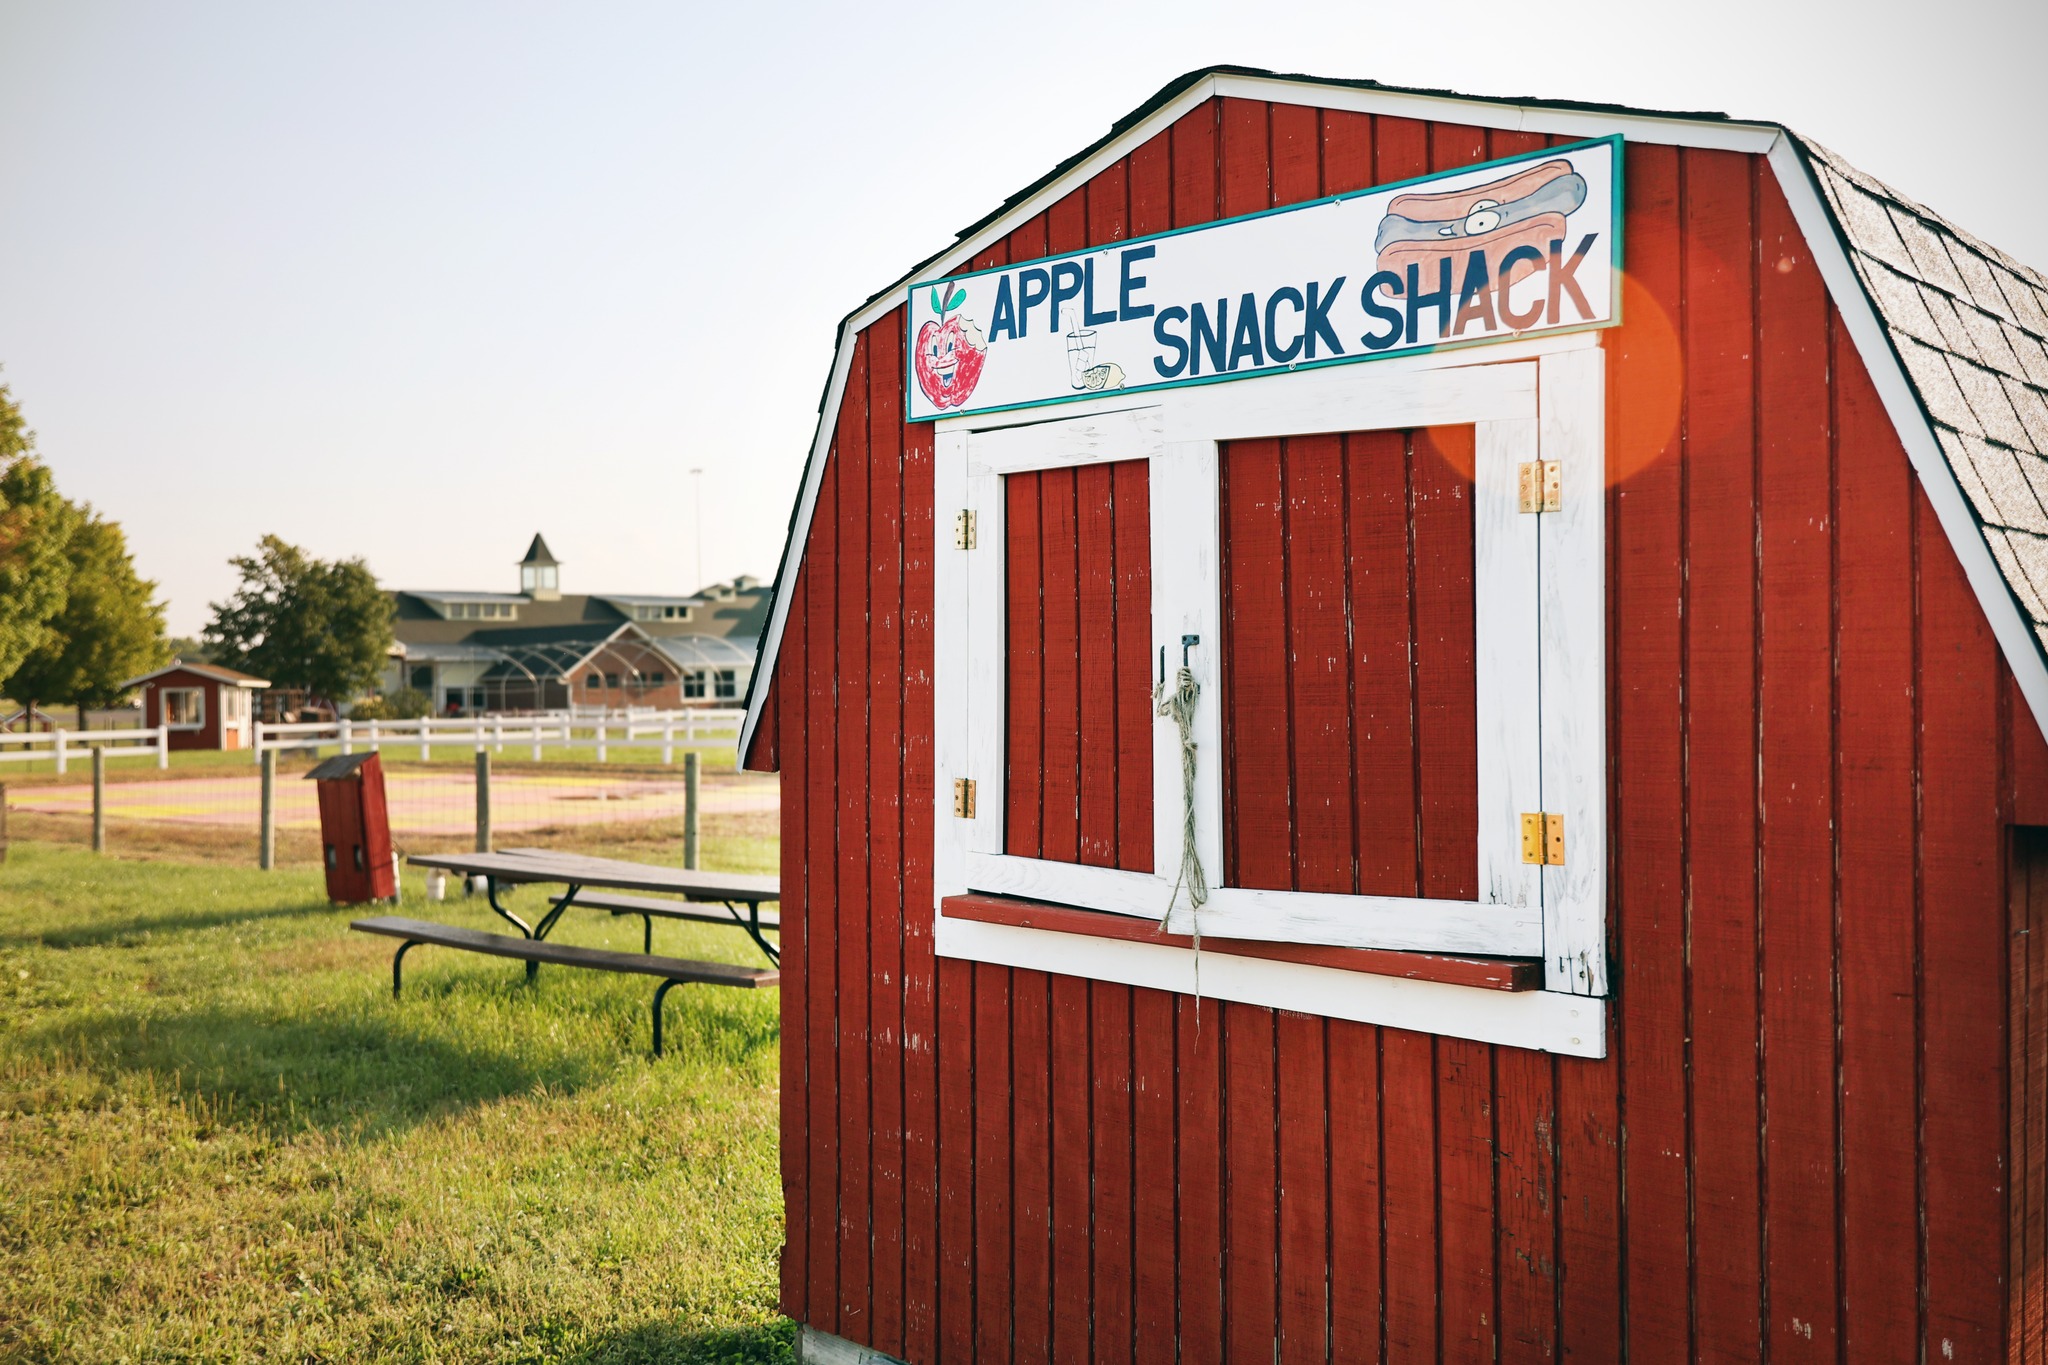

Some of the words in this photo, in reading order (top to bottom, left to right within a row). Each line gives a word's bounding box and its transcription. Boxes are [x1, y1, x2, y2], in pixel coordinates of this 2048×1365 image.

[988, 245, 1156, 342] APPLE
[1153, 276, 1346, 378] SNACK
[1361, 233, 1598, 350] SHACK
